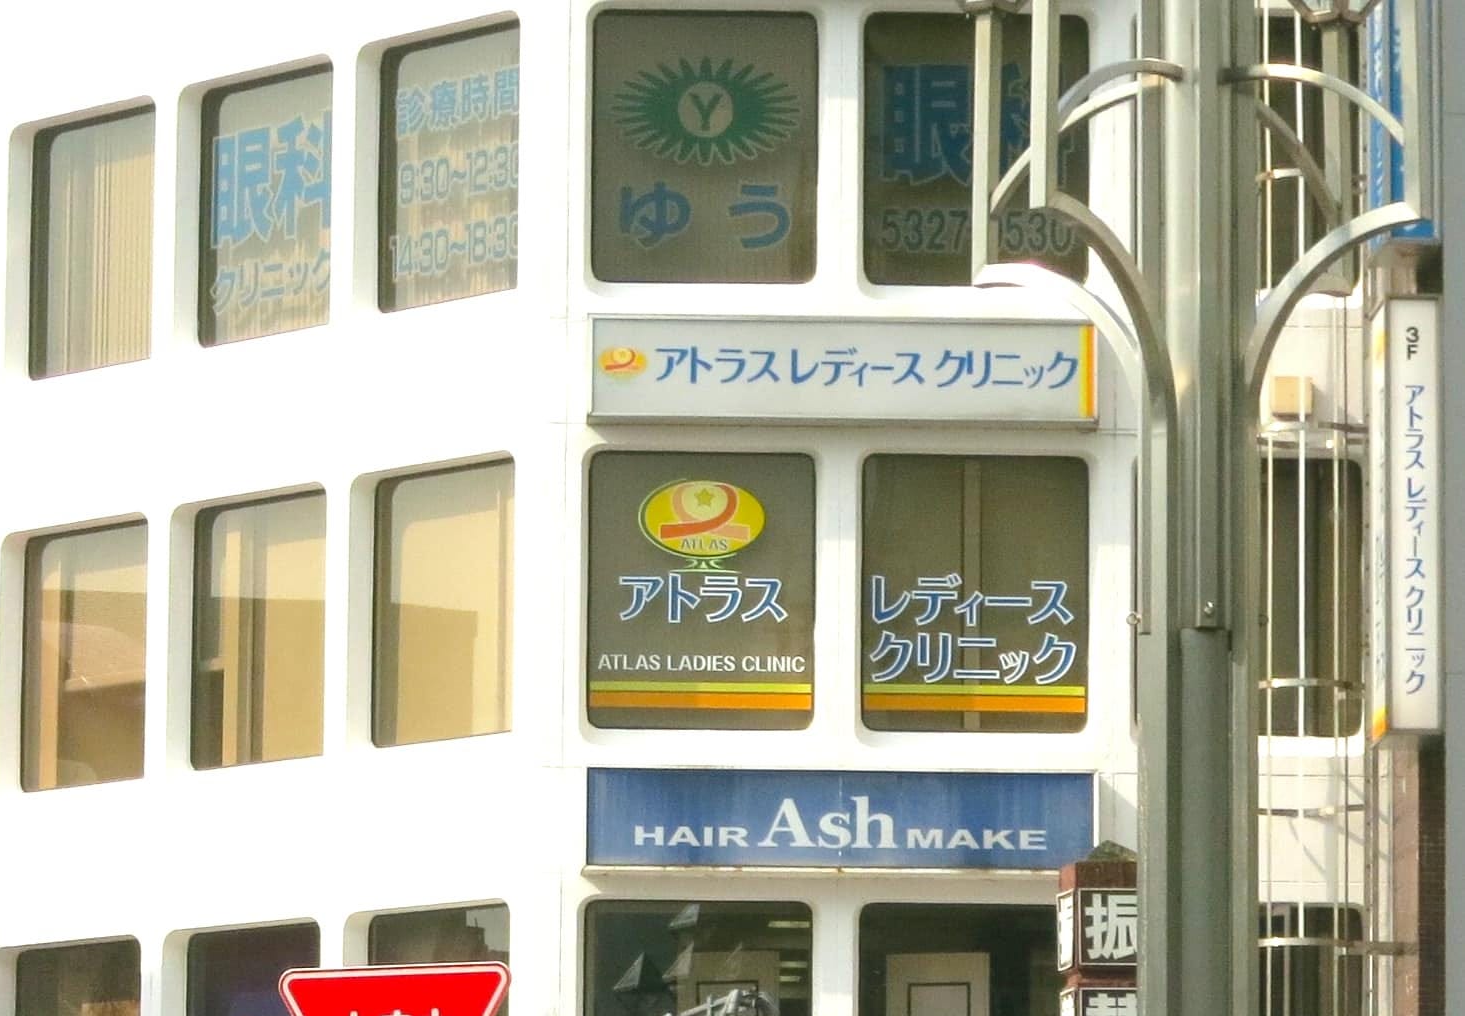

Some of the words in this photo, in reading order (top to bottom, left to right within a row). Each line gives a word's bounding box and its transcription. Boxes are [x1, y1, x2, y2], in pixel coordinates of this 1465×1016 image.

[395, 65, 519, 139] 診療時間
[211, 107, 331, 250] 眼科
[619, 181, 792, 251] ゆう
[210, 249, 331, 317] クリニック
[1405, 326, 1419, 361] 3F
[680, 538, 729, 552] ATLAS
[619, 573, 788, 624] アトラス
[870, 573, 1074, 627] レディース
[598, 655, 661, 672] ATLAS
[667, 655, 737, 672] LADIES
[742, 656, 806, 673] CLINIC
[869, 631, 1076, 684] クリニック
[635, 826, 749, 848] HAIR
[764, 796, 897, 850] Ash
[906, 828, 1048, 851] MAKE
